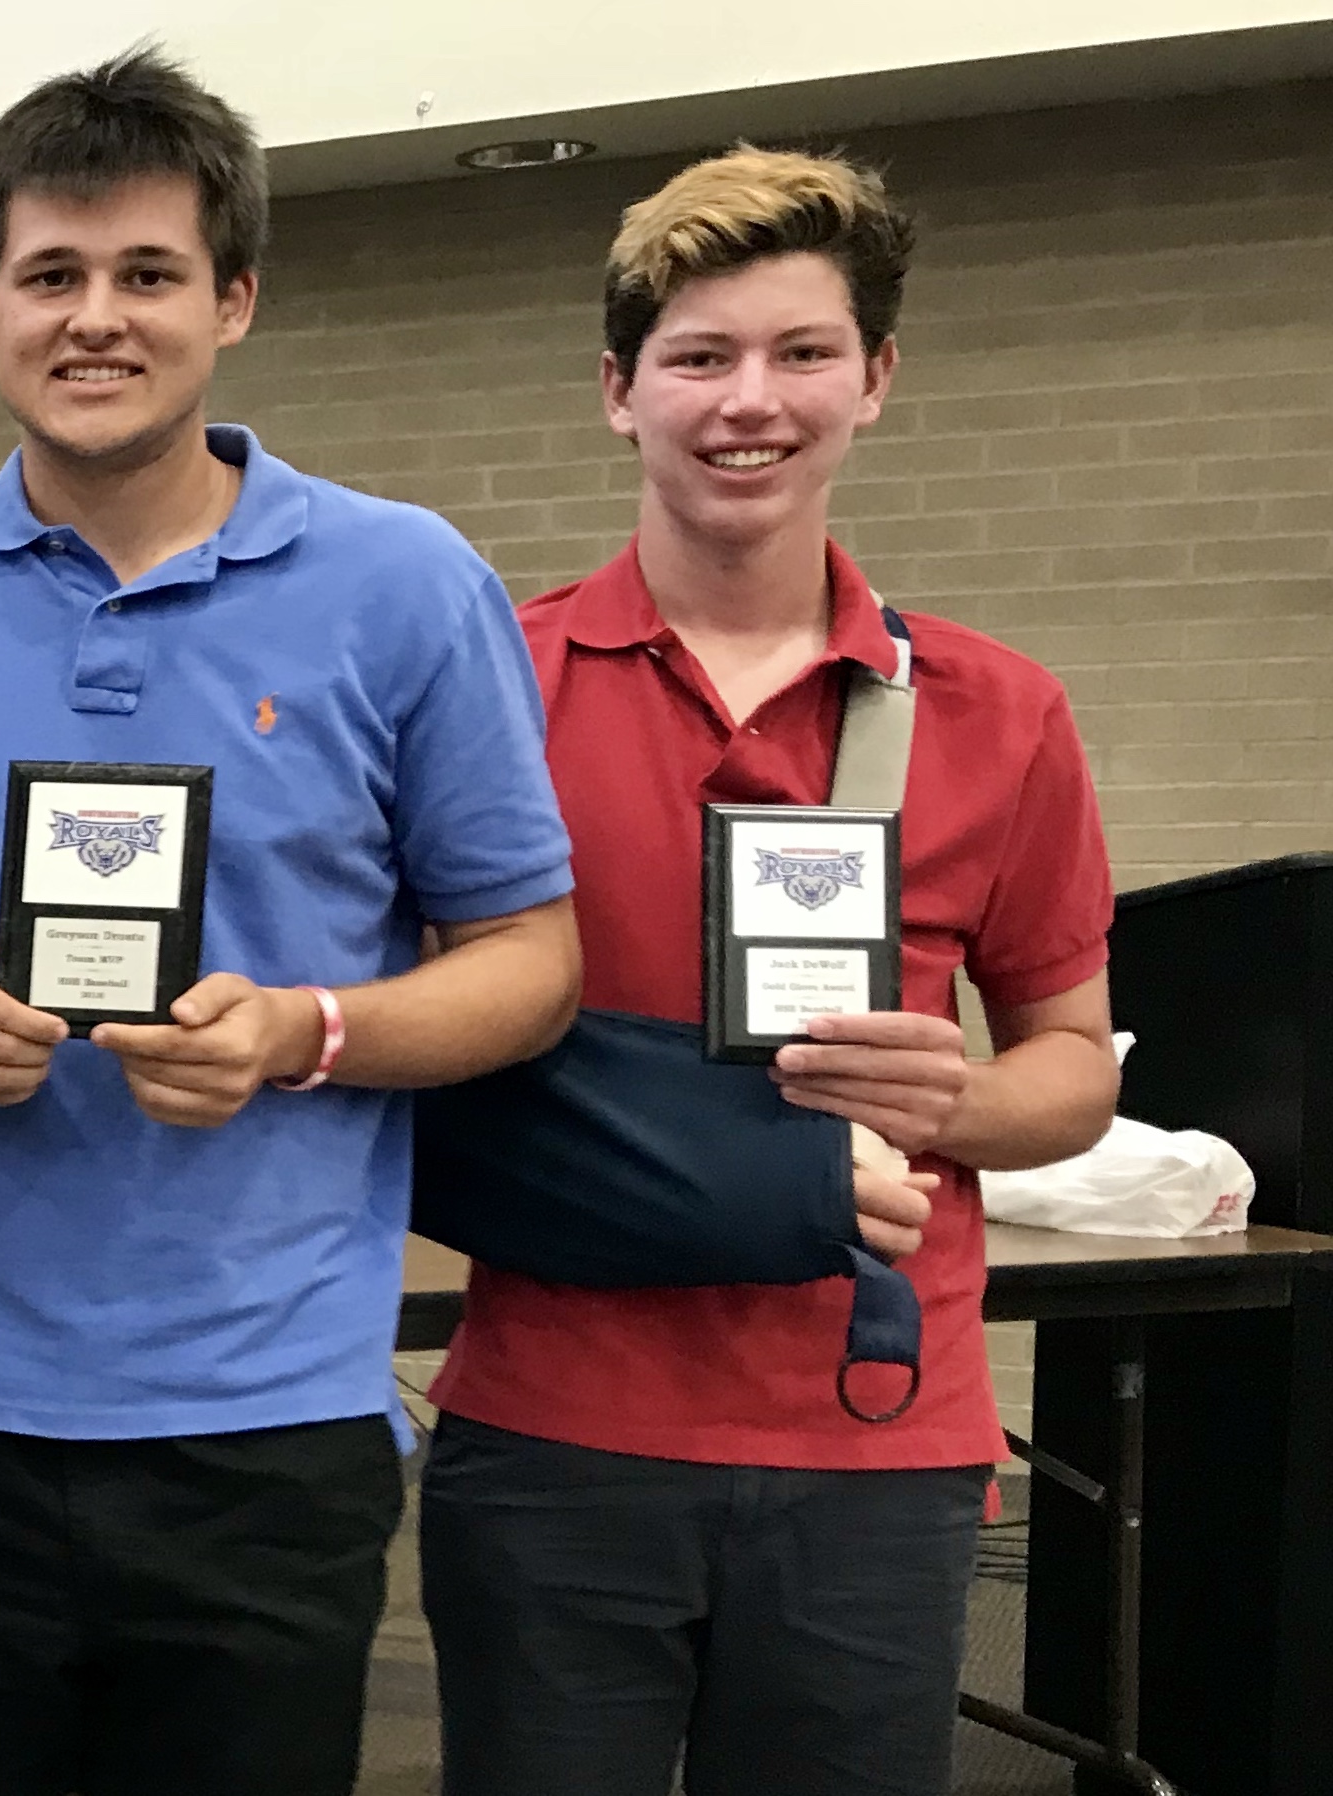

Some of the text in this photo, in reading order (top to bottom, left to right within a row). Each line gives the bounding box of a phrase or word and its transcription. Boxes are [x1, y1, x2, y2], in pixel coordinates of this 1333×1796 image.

[60, 817, 155, 848] ROYALS
[763, 854, 857, 882] ROYALS
[770, 960, 799, 969] Jack
